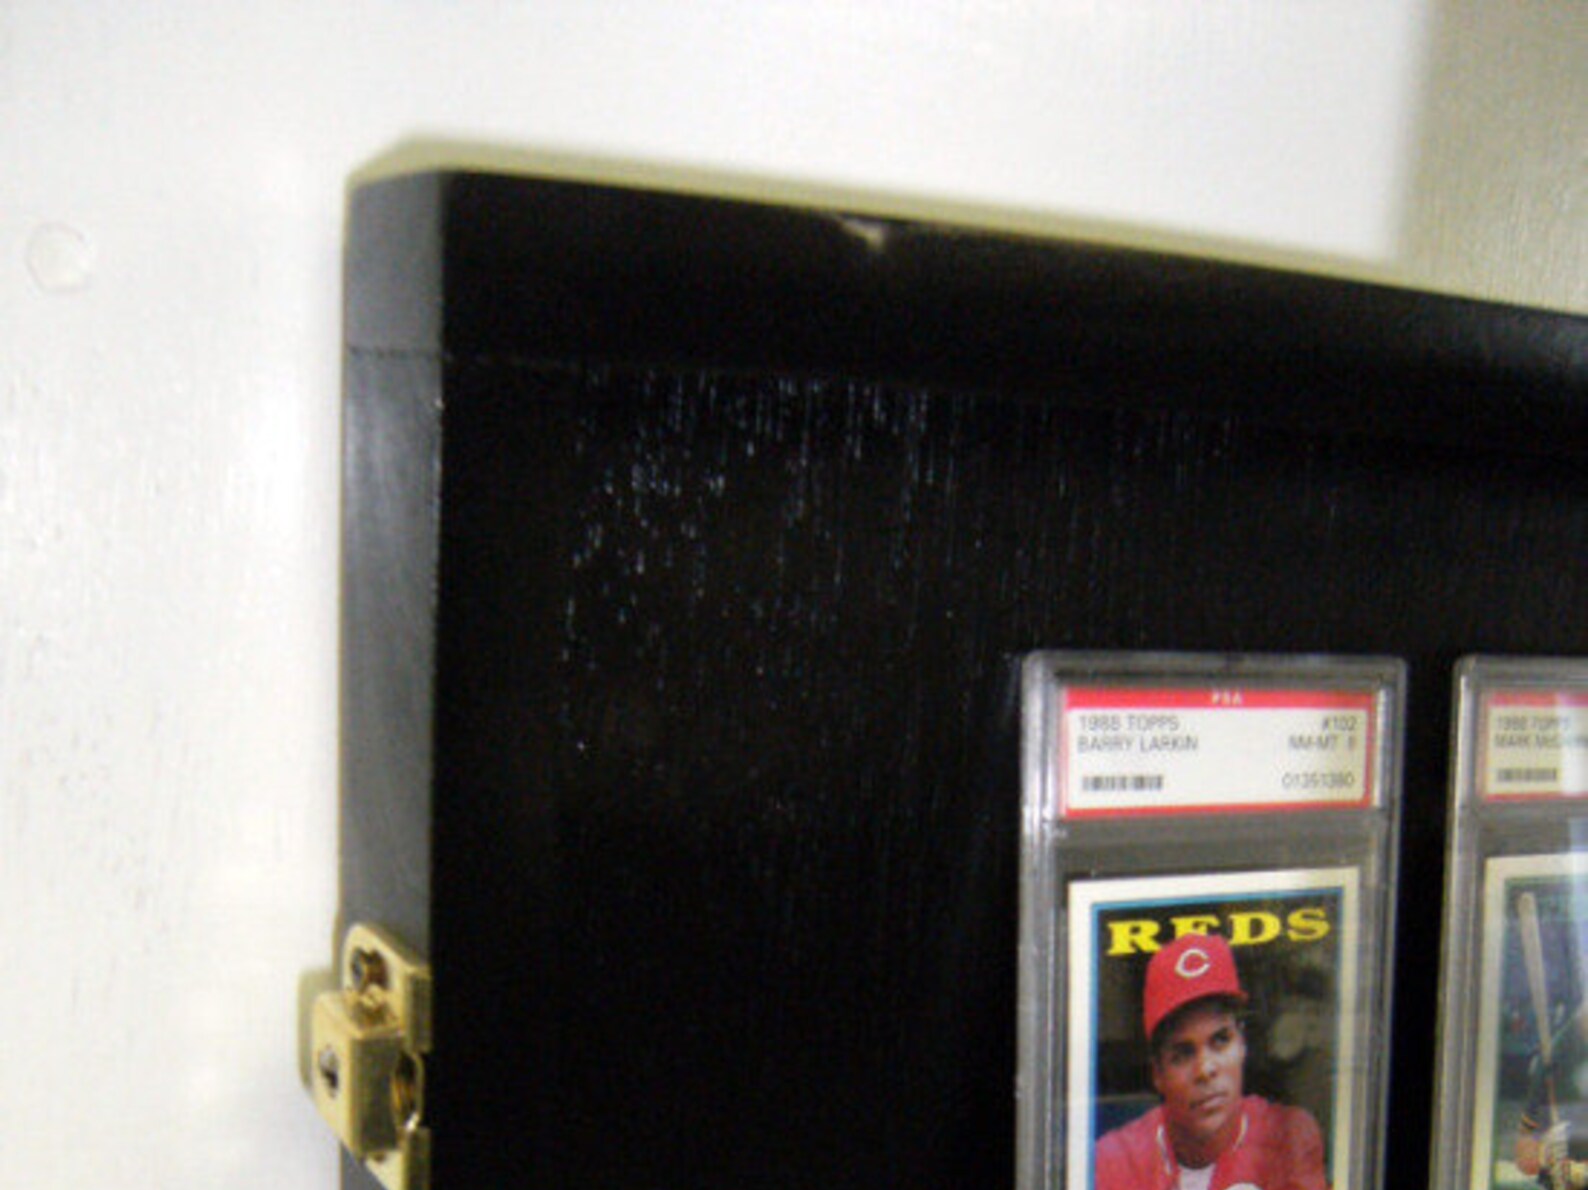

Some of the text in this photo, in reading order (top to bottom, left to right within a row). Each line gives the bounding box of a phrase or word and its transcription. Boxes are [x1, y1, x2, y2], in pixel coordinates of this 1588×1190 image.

[1126, 714, 1180, 731] TOPPS
[1077, 735, 1199, 753] BARRY LARKIN
[1106, 907, 1332, 957] REDS
[1174, 948, 1211, 979] C
